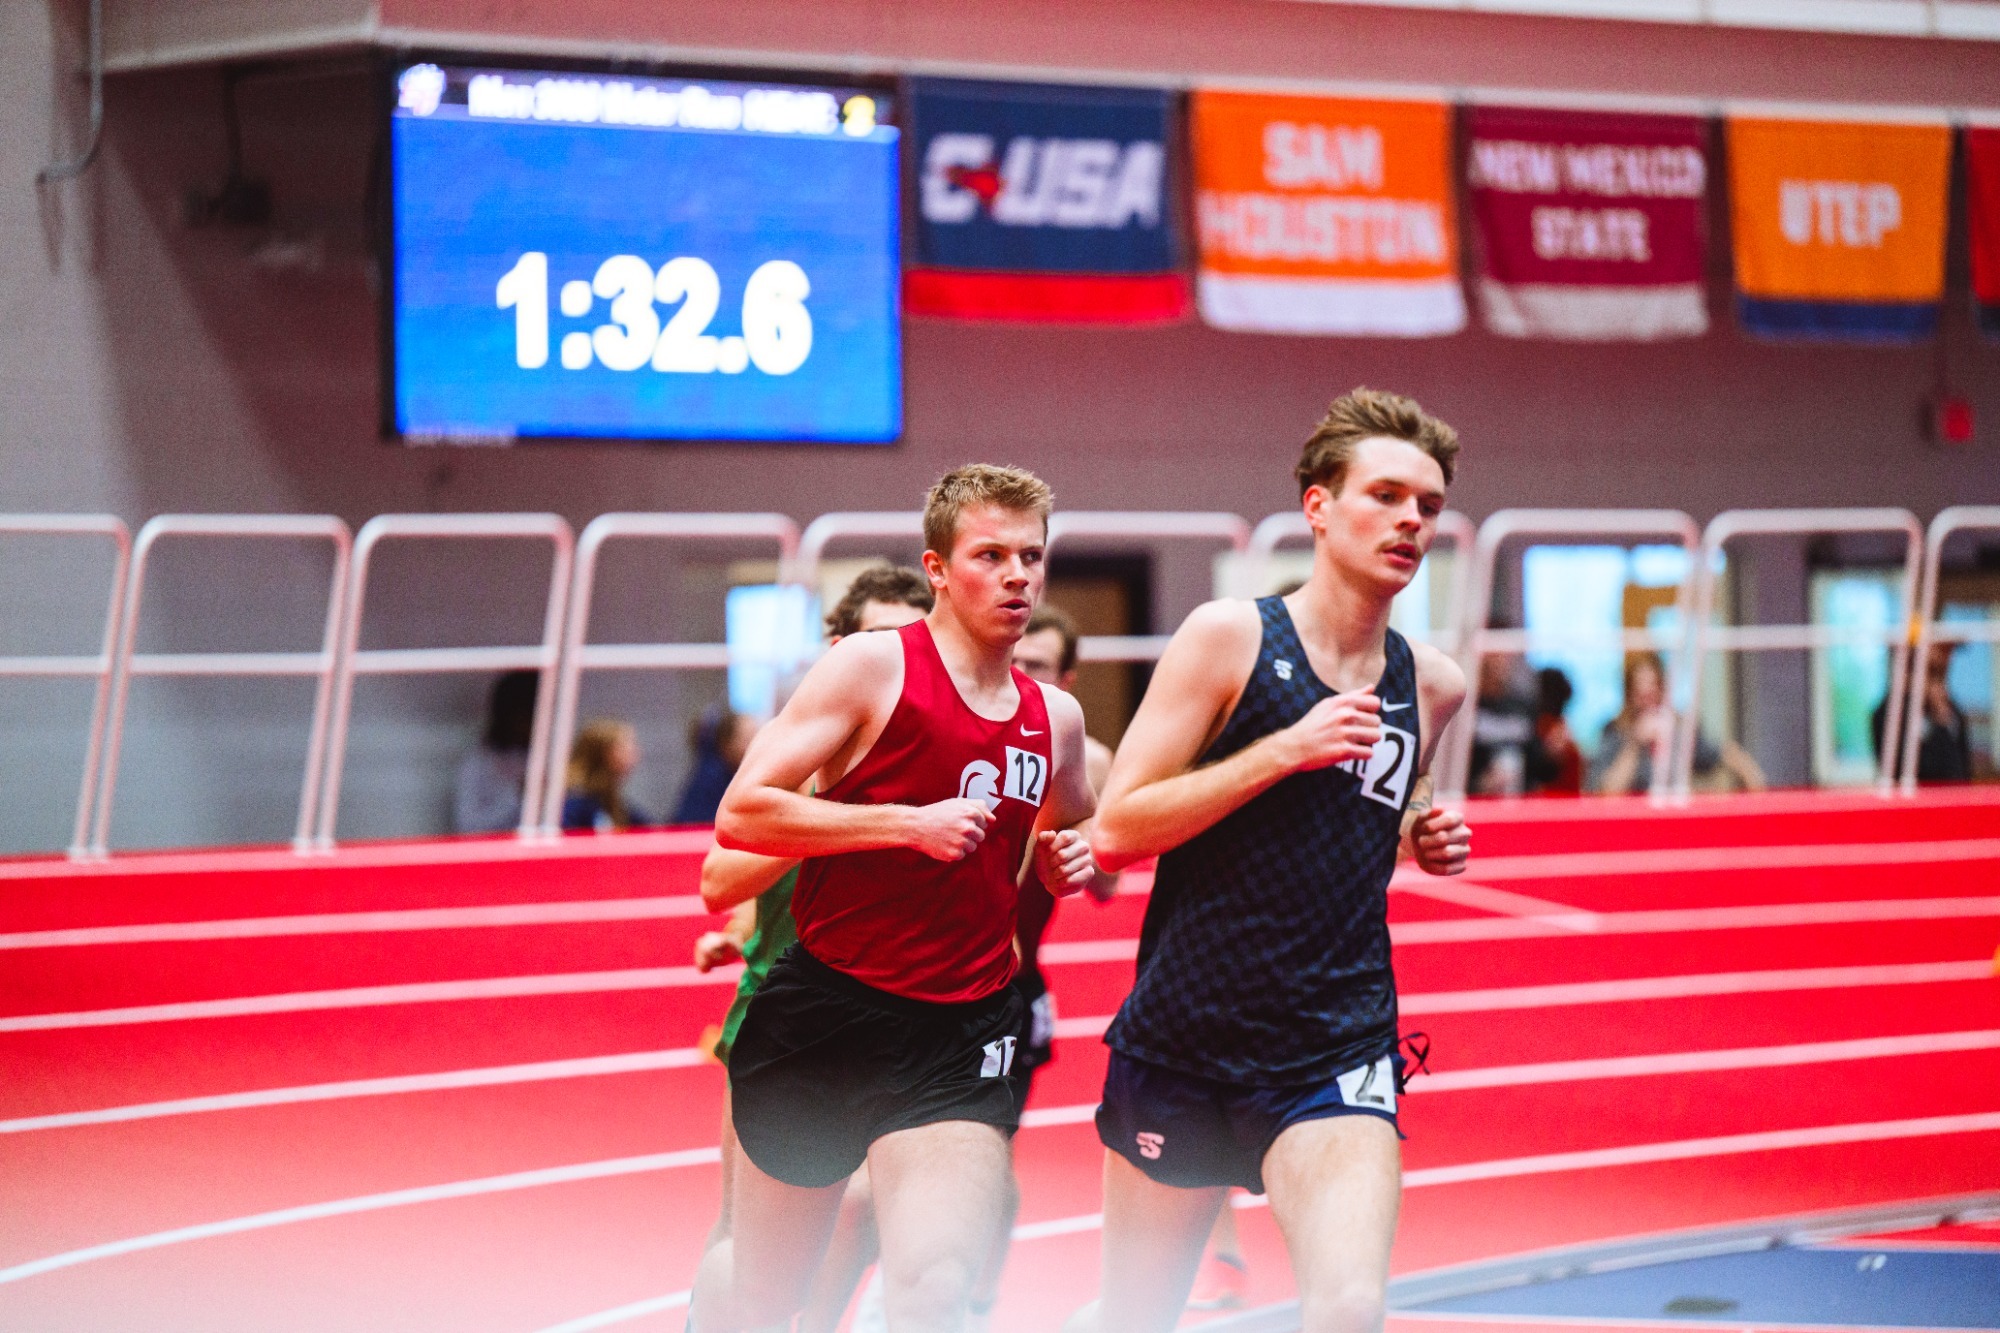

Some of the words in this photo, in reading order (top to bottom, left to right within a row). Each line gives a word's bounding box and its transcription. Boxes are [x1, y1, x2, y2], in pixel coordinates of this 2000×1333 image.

[1264, 121, 1383, 190] SAM
[1470, 141, 1559, 194] NEW
[1566, 145, 1706, 198] MEXICO
[1199, 192, 1448, 264] HOUSTON
[1532, 207, 1651, 262] STATE
[1780, 180, 1901, 248] UTEP
[497, 251, 813, 375] 1:32.6
[1014, 752, 1041, 802] 12
[1372, 732, 1405, 801] 2
